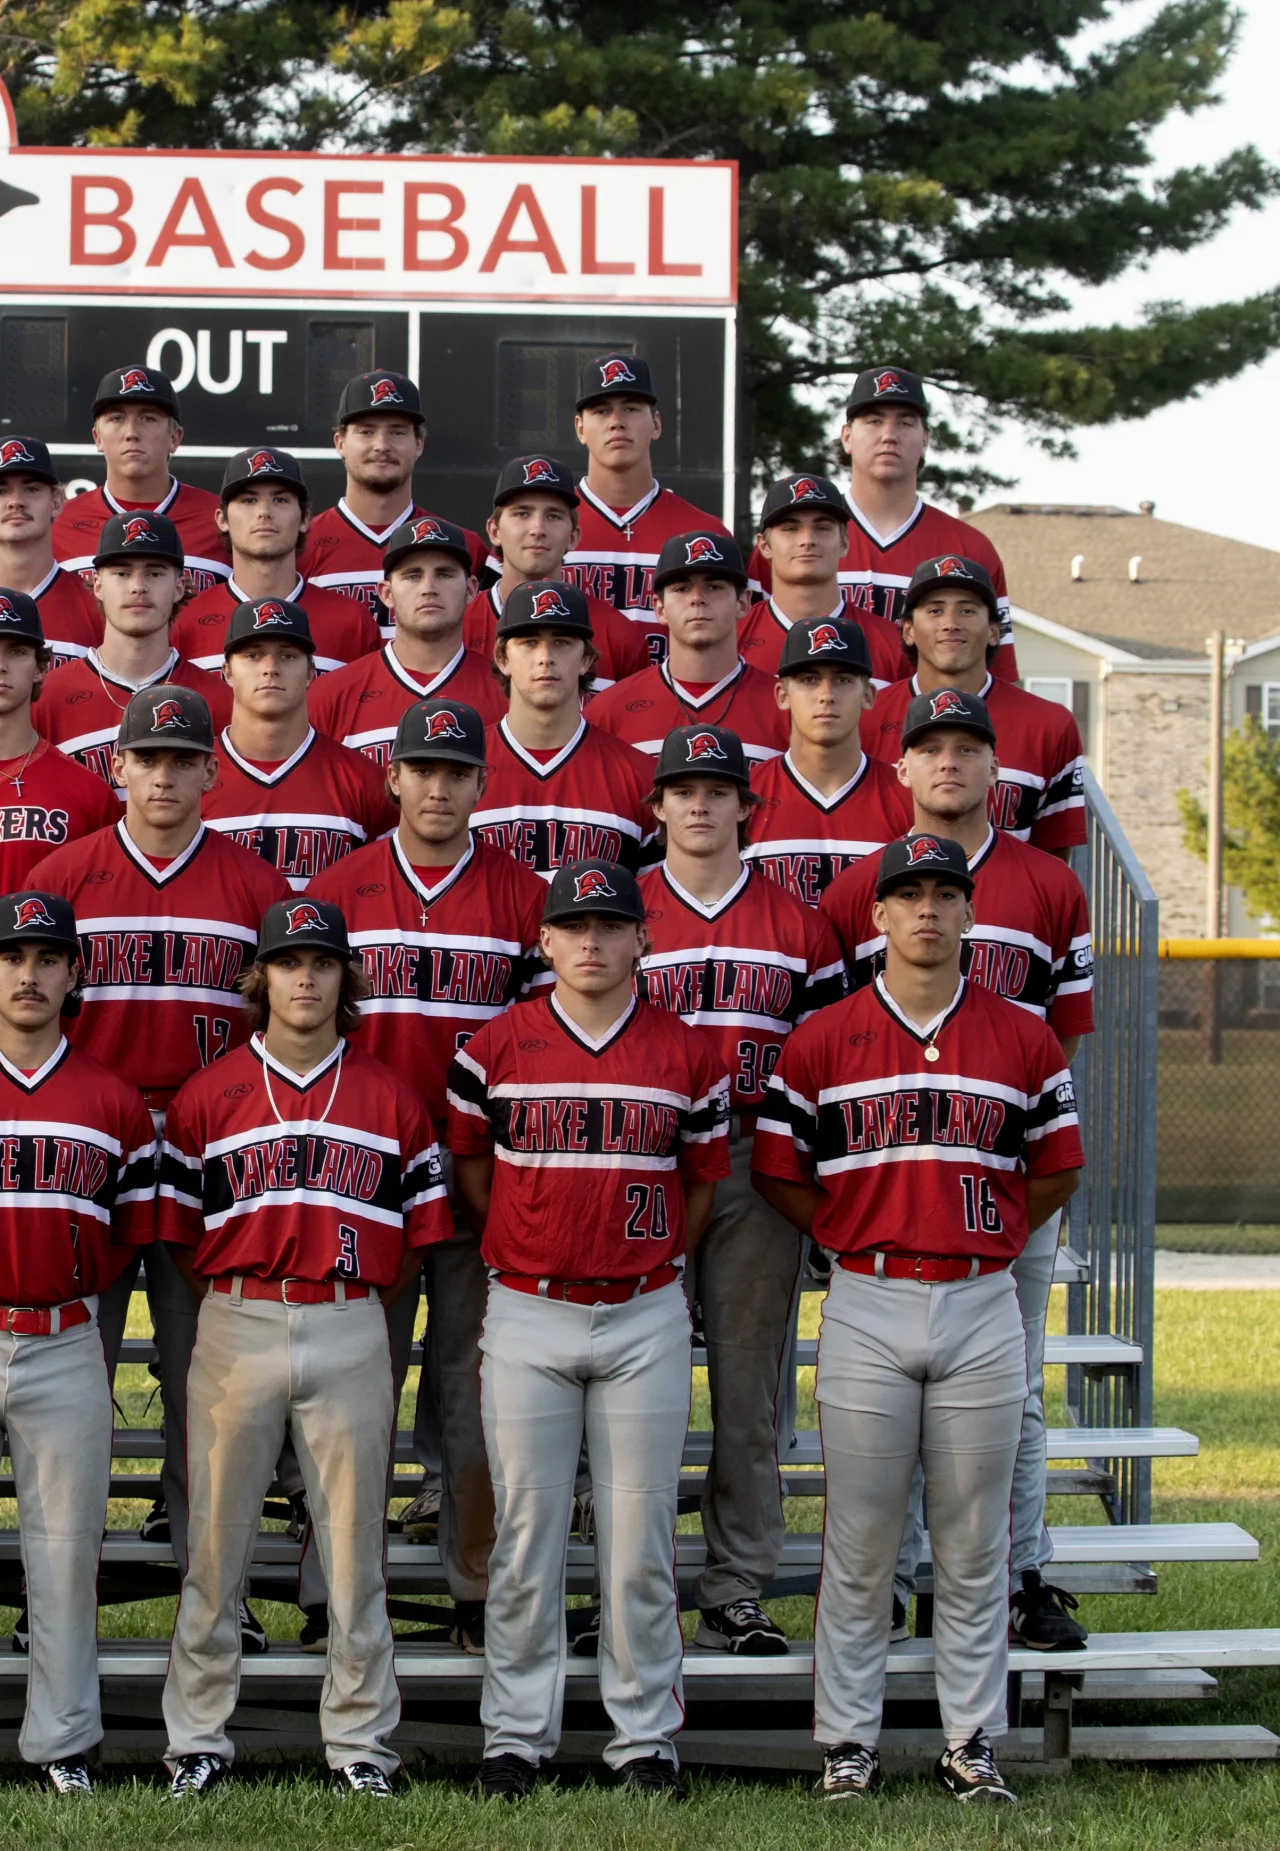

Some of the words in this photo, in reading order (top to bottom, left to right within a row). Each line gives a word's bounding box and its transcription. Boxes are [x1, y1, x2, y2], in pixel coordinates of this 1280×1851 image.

[69, 174, 704, 277] BASEBALL
[146, 327, 289, 395] OUT
[561, 564, 616, 607] AKE
[624, 566, 658, 609] LA
[478, 821, 537, 869] AKE
[547, 820, 622, 868] LAND
[747, 856, 822, 904] AKE
[163, 932, 245, 990] LAND
[358, 947, 421, 998] AKE
[430, 949, 513, 1005] LAND
[633, 961, 706, 1014] AKE
[712, 960, 793, 1017] LAND
[966, 941, 1031, 998] AND
[508, 1099, 589, 1152] LAKE
[839, 1091, 920, 1153] LAKE
[929, 1091, 1007, 1151] LAND
[32, 1137, 109, 1199] LAND
[222, 1138, 299, 1201] LAKE
[305, 1136, 384, 1201] LAND
[624, 1182, 671, 1241] 20
[335, 1223, 361, 1280] 3
